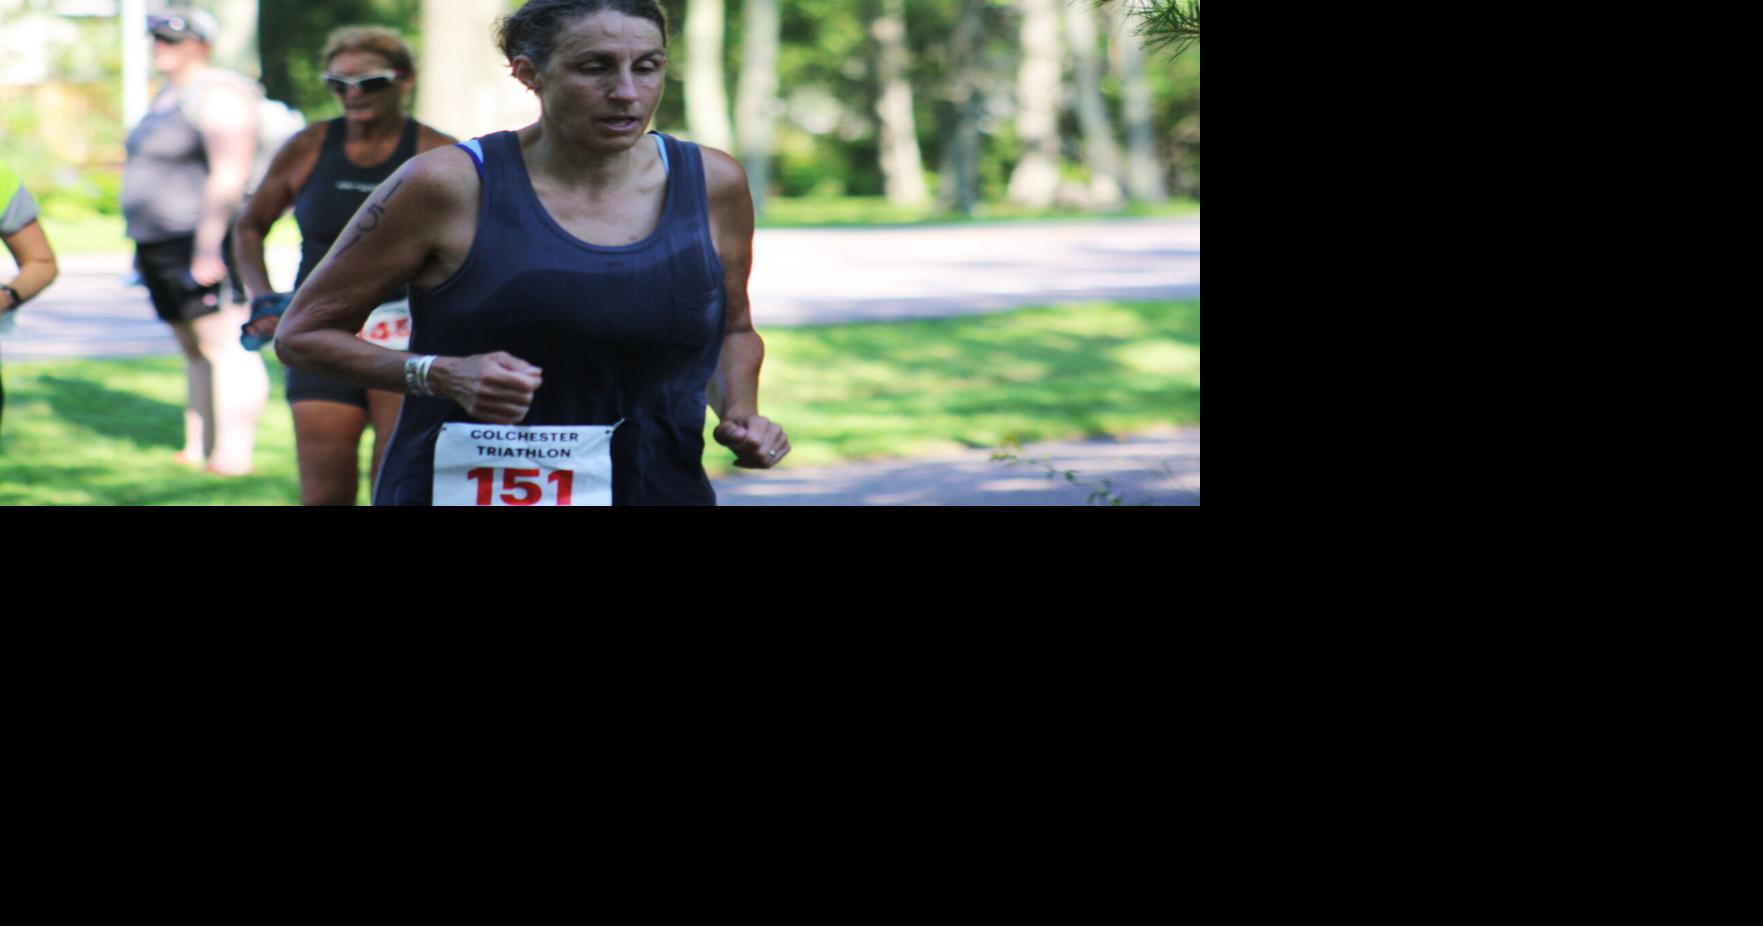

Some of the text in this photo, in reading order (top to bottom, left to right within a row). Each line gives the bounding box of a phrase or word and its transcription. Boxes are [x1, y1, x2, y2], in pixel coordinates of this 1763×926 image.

[470, 429, 579, 442] COLCHESTER
[477, 446, 571, 458] TRIATHLON
[467, 466, 574, 506] 151
